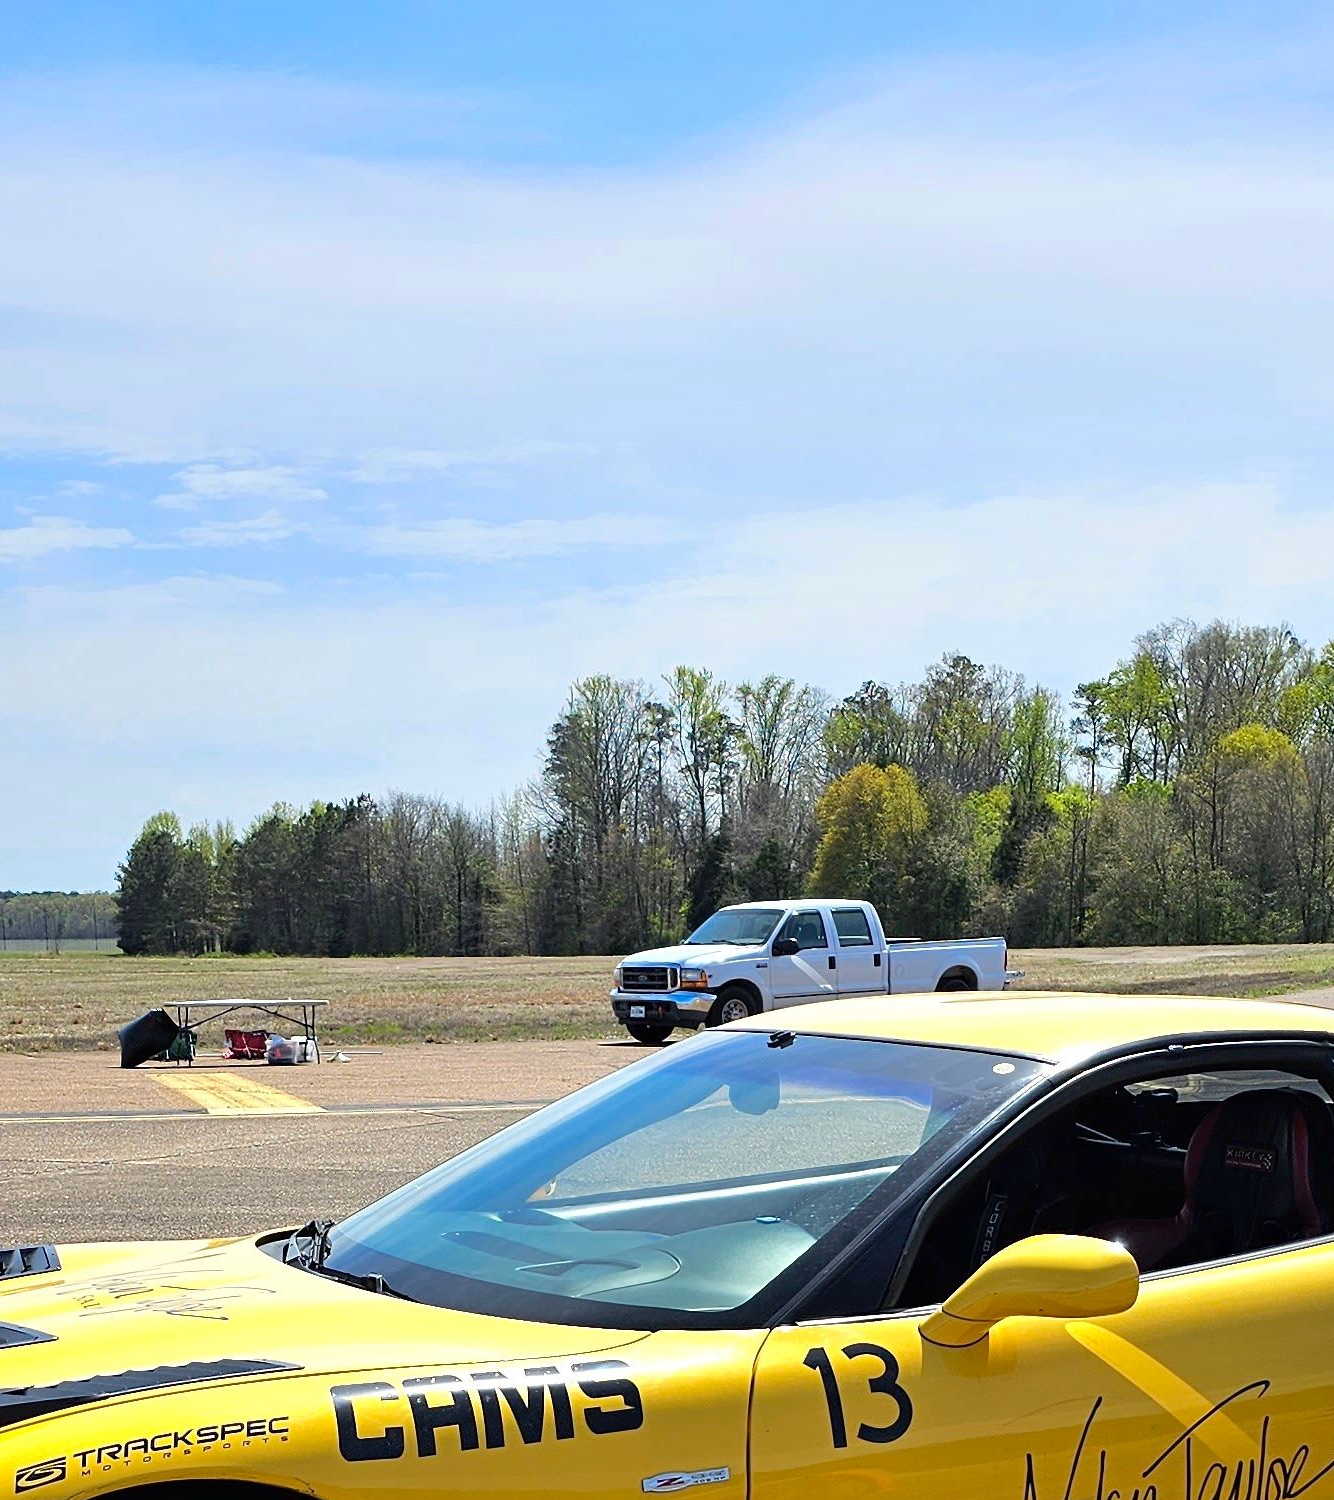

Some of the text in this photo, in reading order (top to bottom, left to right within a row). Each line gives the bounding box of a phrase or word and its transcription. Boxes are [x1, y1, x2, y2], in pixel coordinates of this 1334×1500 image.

[803, 1343, 913, 1448] 13
[73, 1417, 288, 1468] TRACKSPEC
[81, 1437, 288, 1476] MOTORSPORTS
